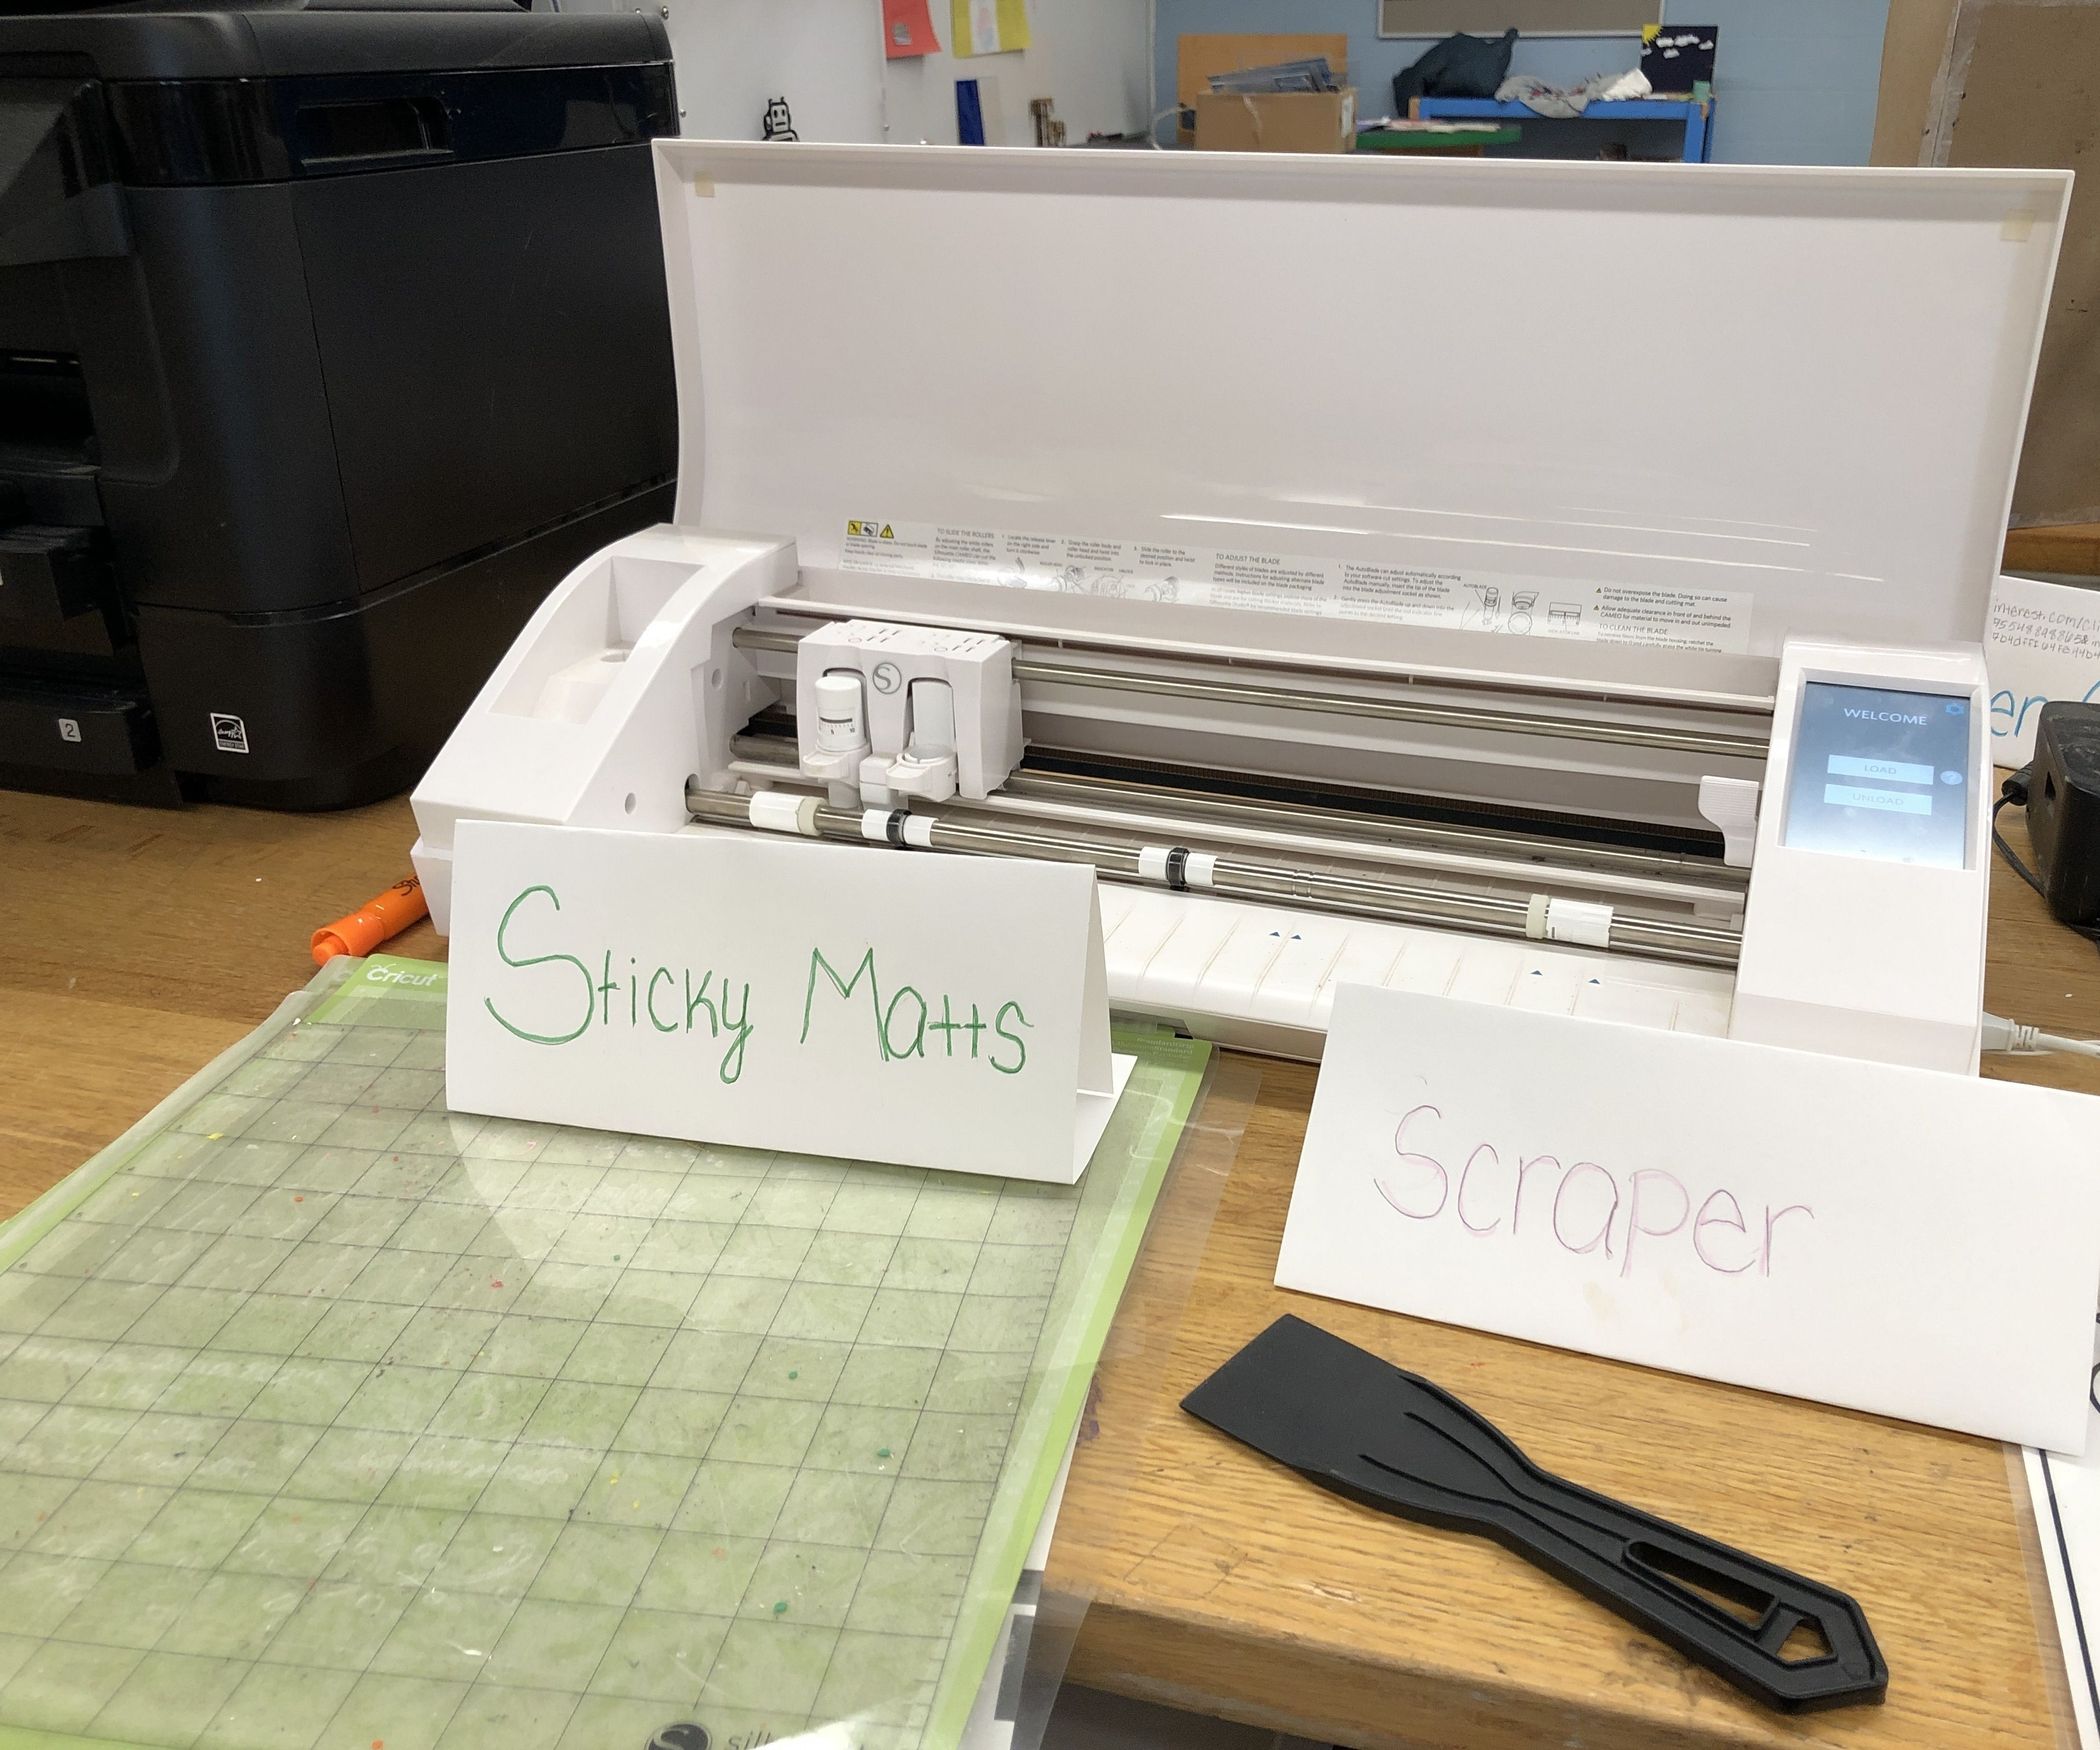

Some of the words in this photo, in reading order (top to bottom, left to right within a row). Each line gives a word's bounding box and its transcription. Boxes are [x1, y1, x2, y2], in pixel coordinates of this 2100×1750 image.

[1225, 554, 1248, 562] ADJUST
[1843, 708, 1928, 725] WELCOME
[64, 723, 76, 738] 2
[1864, 764, 1897, 775] LOAD
[1852, 793, 1905, 806] UNLOAD
[366, 963, 437, 987] Cricut
[484, 884, 755, 1085] Sticky
[800, 946, 1035, 1075] Matts
[1372, 1103, 1816, 1279] Scraper
